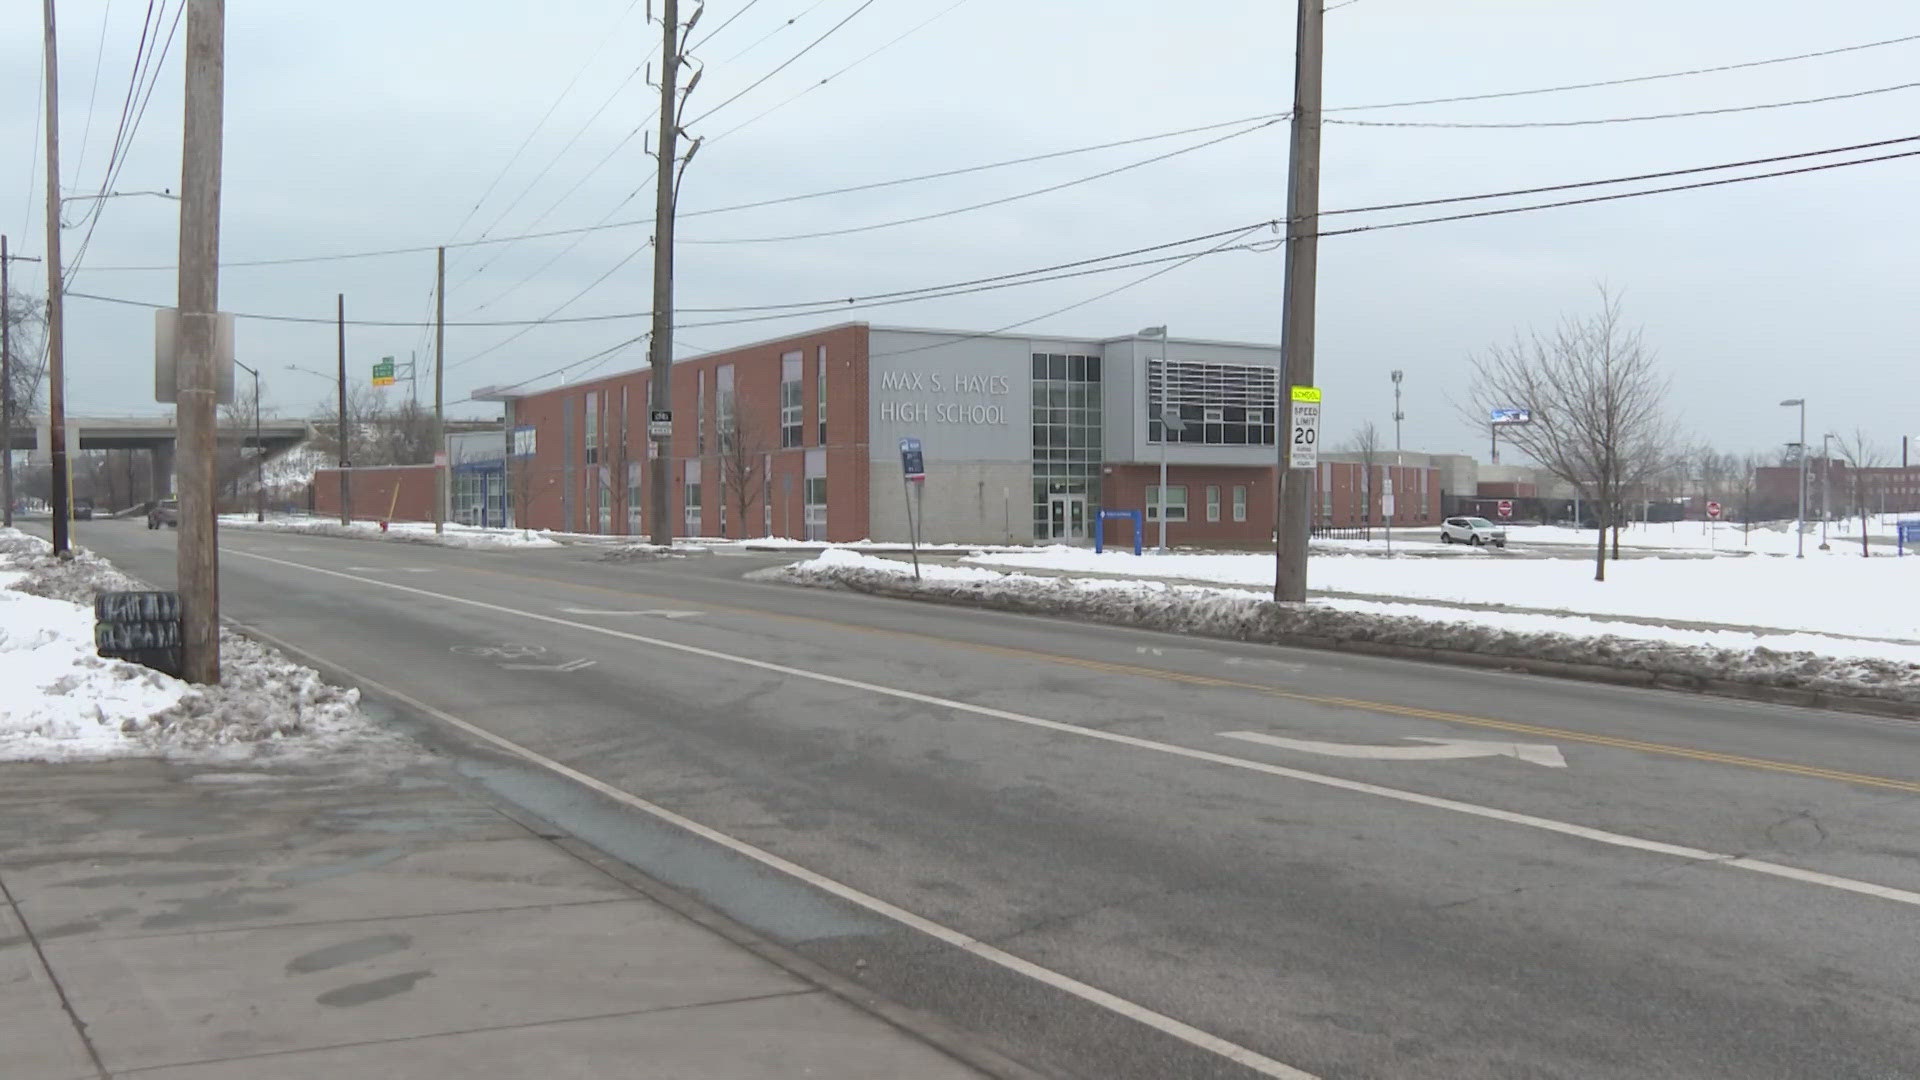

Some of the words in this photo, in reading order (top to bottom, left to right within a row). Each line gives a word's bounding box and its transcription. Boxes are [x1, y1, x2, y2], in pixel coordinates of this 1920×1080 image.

[881, 371, 923, 391] MAX
[930, 372, 946, 393] S.
[955, 373, 1009, 394] HAYES
[880, 402, 928, 422] HIGH
[936, 403, 1009, 425] SCHOOL
[1294, 407, 1318, 416] SPEED
[1295, 417, 1315, 426] LIMIT
[1294, 427, 1315, 444] 20
